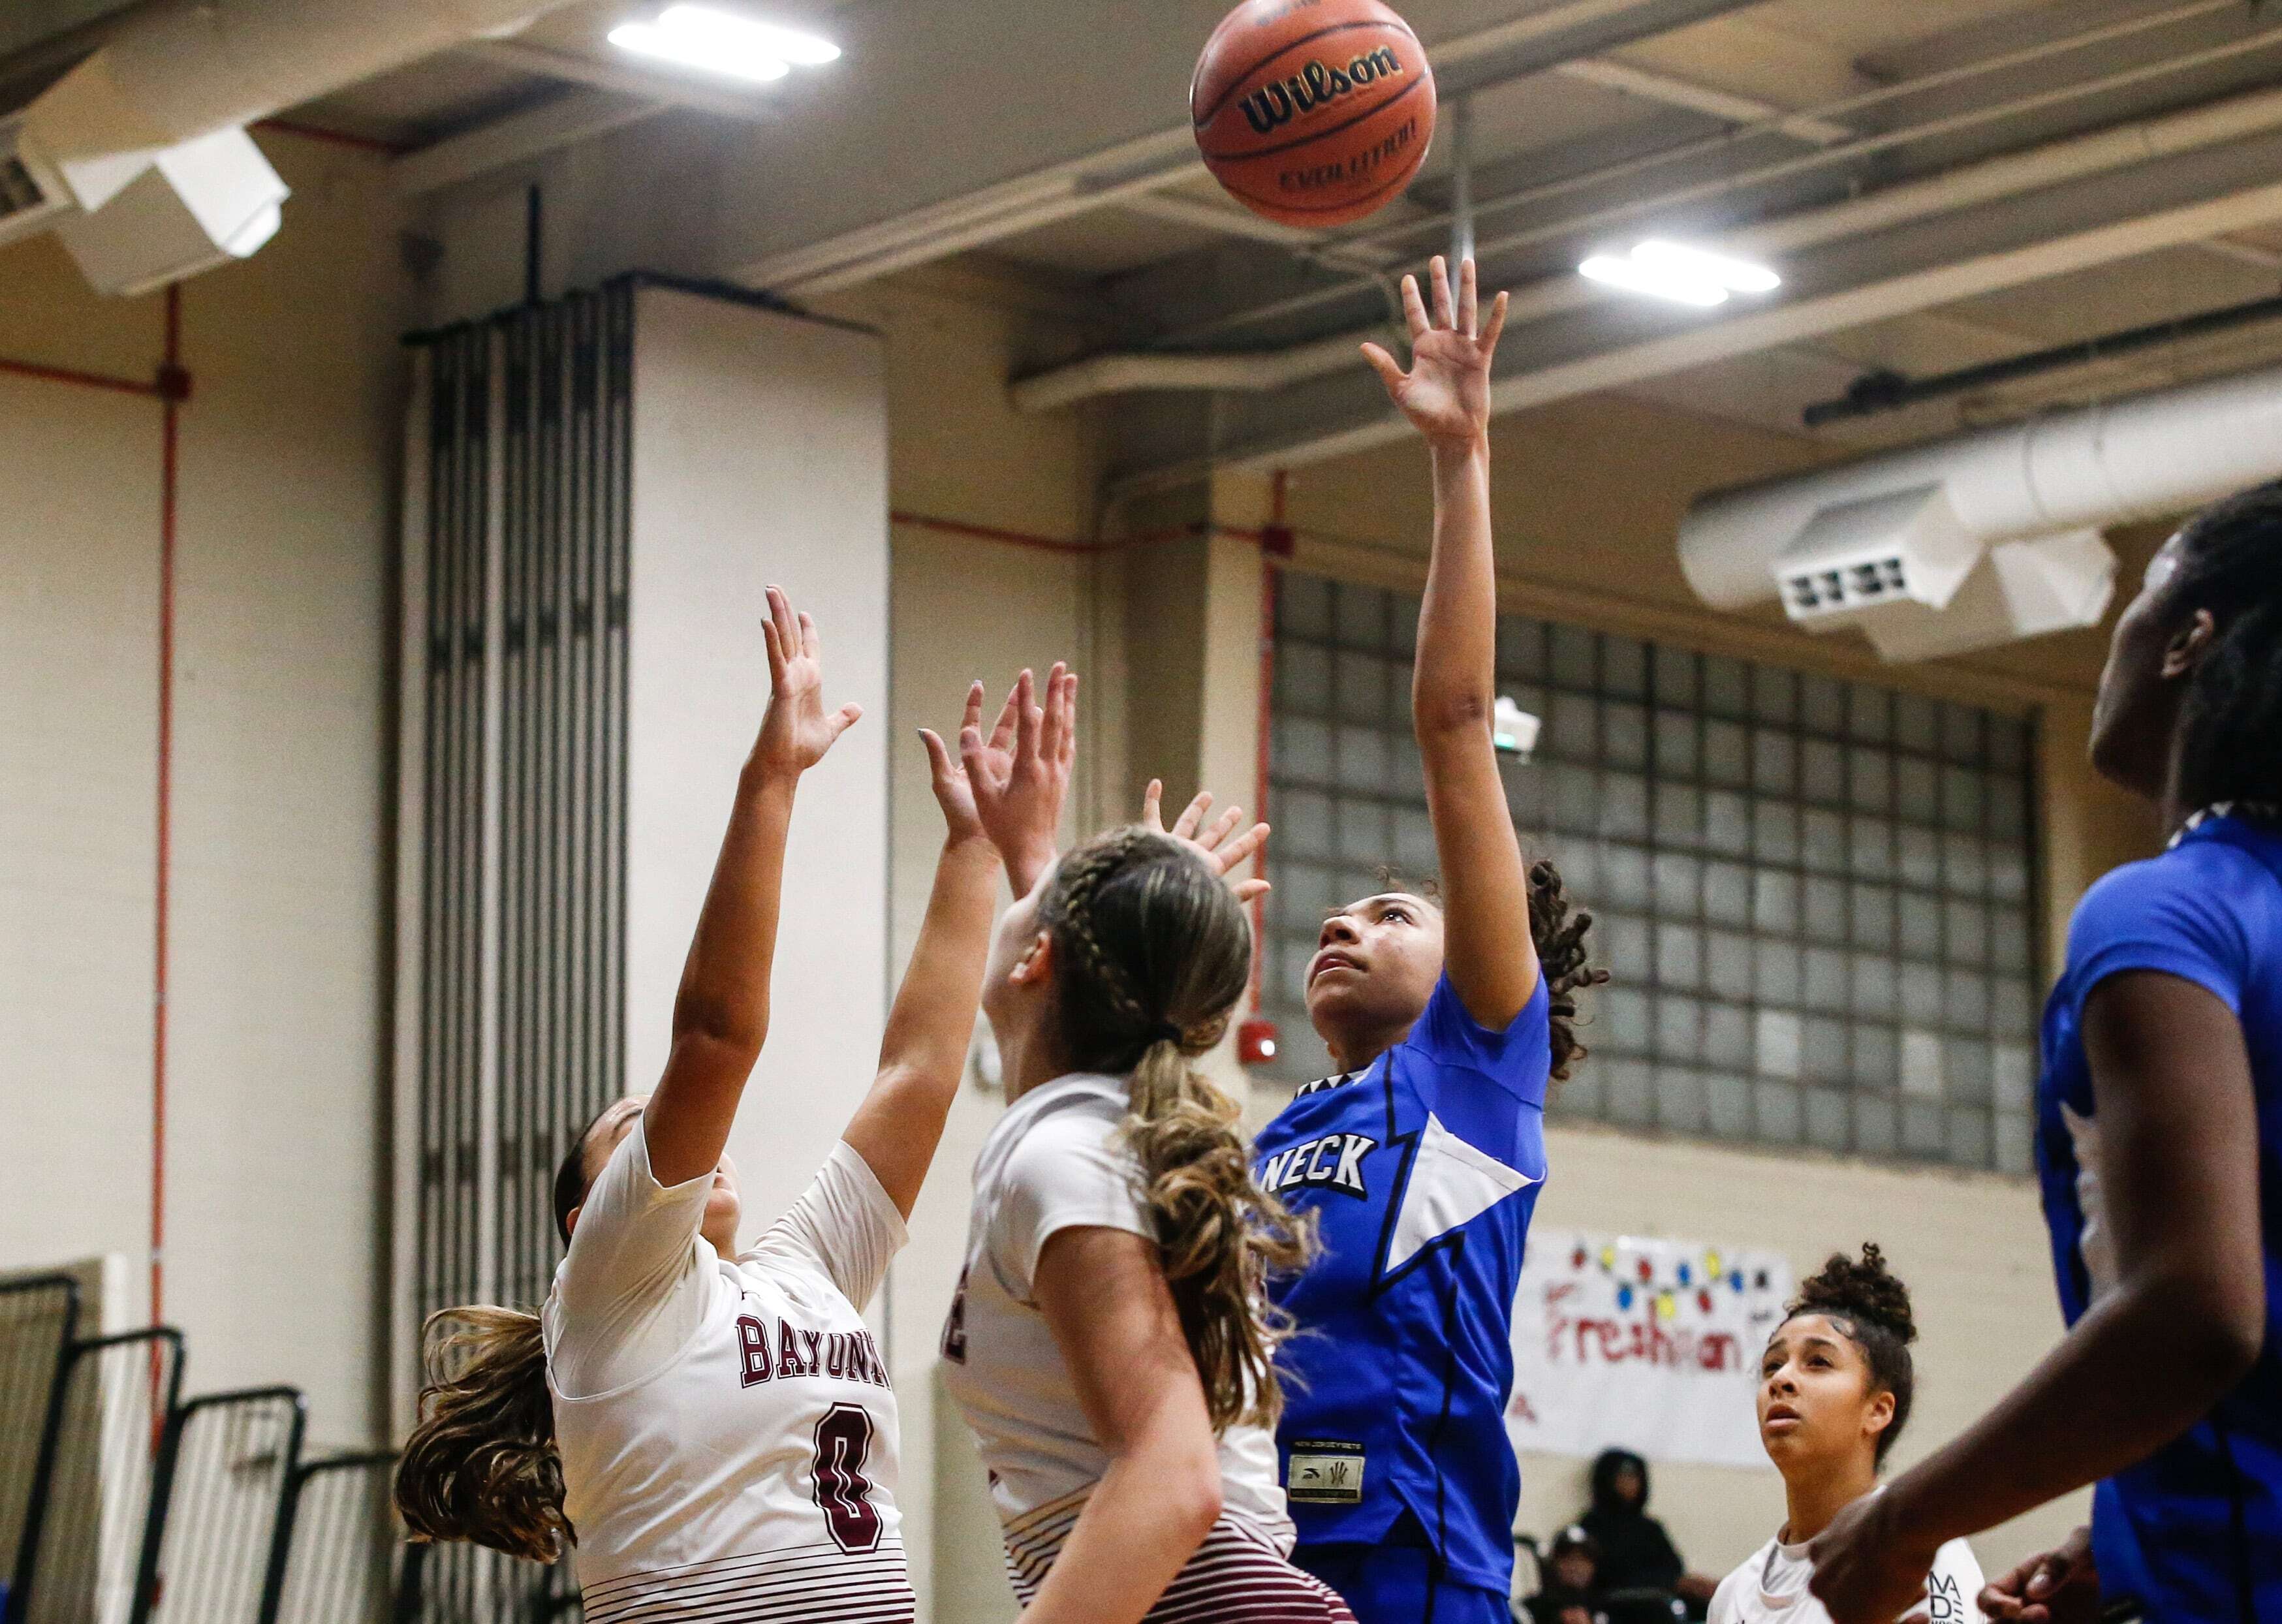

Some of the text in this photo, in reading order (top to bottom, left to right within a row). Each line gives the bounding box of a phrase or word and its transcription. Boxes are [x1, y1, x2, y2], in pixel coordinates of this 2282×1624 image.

[1238, 46, 1403, 133] Wilson
[1249, 1134, 1375, 1193] NECK
[811, 1402, 883, 1555] 0
